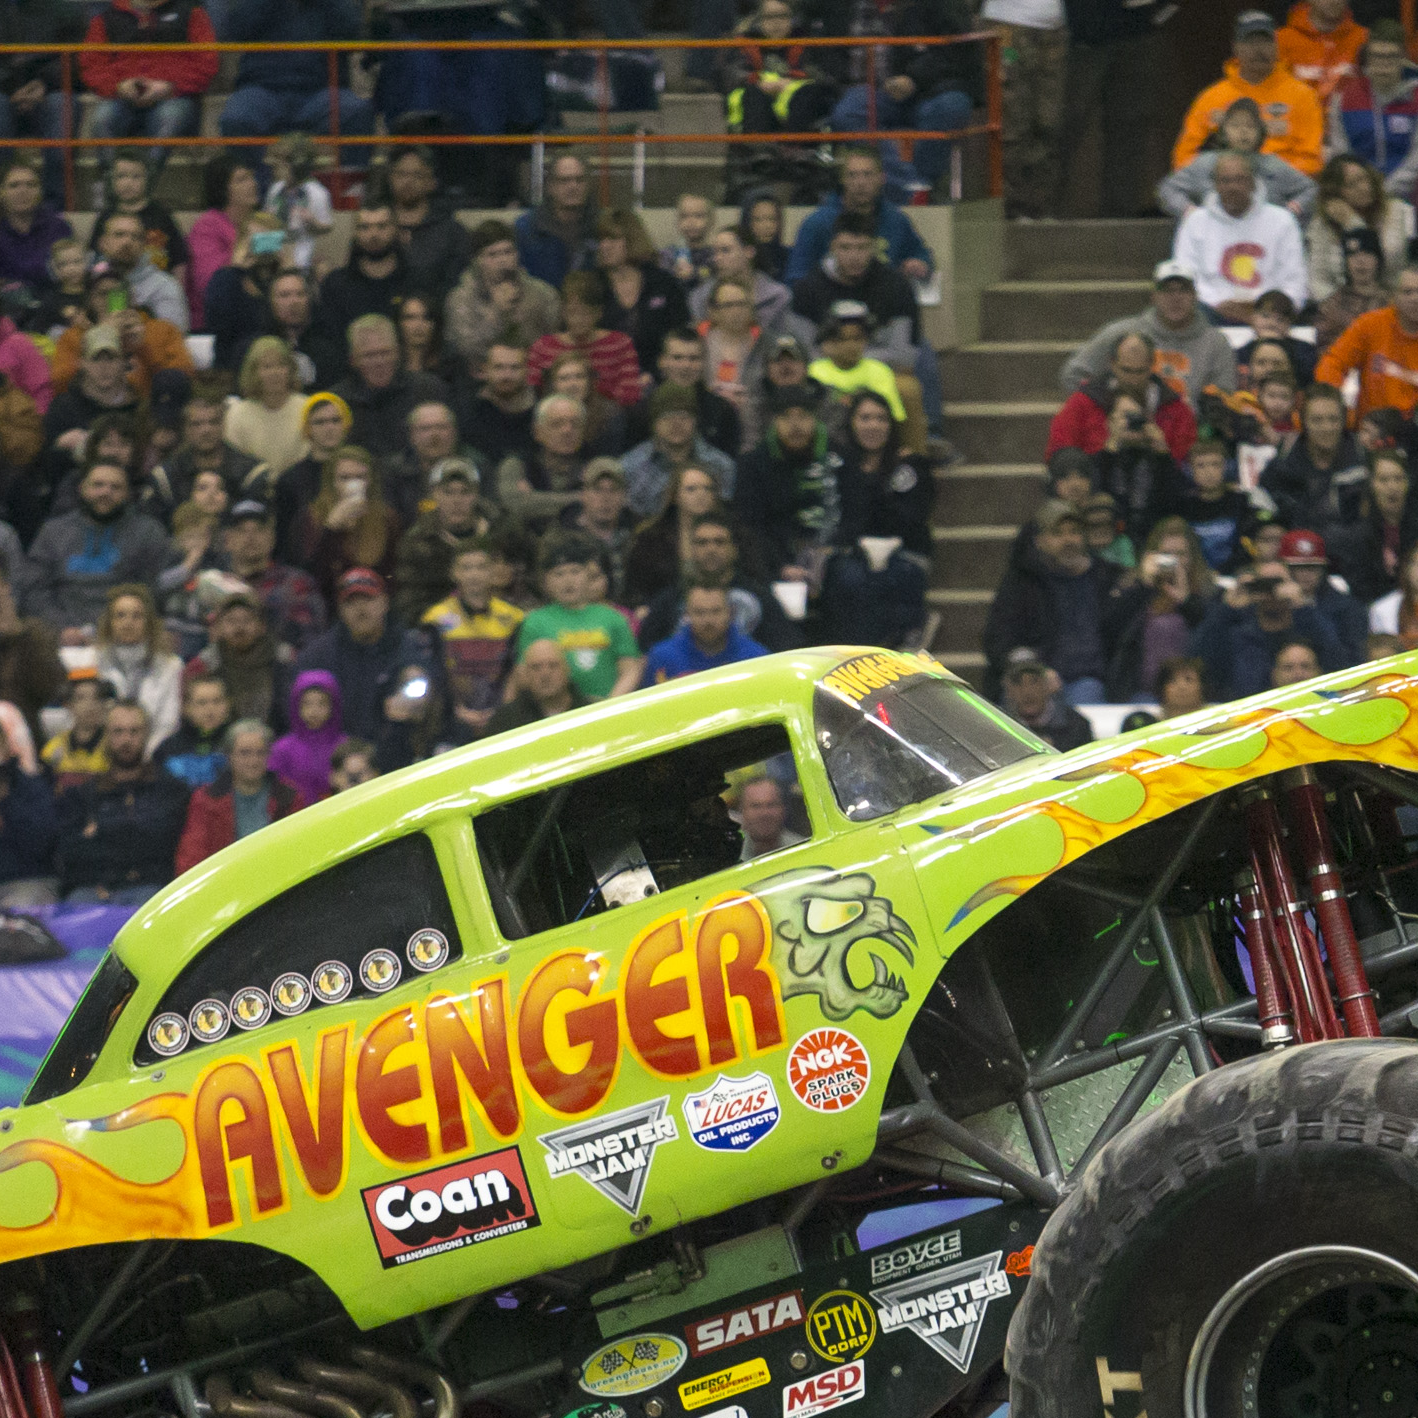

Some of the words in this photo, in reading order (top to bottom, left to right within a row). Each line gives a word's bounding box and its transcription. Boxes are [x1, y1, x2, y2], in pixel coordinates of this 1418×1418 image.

[823, 653, 922, 701] AVENGE
[188, 889, 789, 1234] AVENGER
[796, 1042, 853, 1077] NGK
[807, 1067, 857, 1092] SPARK
[811, 1080, 861, 1105] PLUGS
[698, 1129, 719, 1144] OIL
[719, 1110, 778, 1138] PRODUCTS
[700, 1089, 769, 1128] LUCAS
[546, 1118, 677, 1177] MONSTER
[590, 1153, 649, 1183] JAM
[375, 1169, 511, 1231] Coan
[395, 1238, 464, 1265] TRANSMISSIONS
[465, 1235, 473, 1246] &
[473, 1219, 529, 1243] CONVERTERS
[871, 1229, 962, 1278] BOYCE
[871, 1267, 912, 1285] EQUIPMENT
[943, 1250, 963, 1264] UTAH
[879, 1271, 1010, 1332] MONSTER
[697, 1295, 802, 1351] SATA
[813, 1300, 867, 1347] PTM
[923, 1303, 979, 1338] JAM
[827, 1334, 869, 1356] CORP
[684, 1372, 733, 1397] ENERGY
[708, 1370, 766, 1394] SUSPENSION
[787, 1365, 862, 1412] MSD
[801, 1407, 817, 1418] MAG
